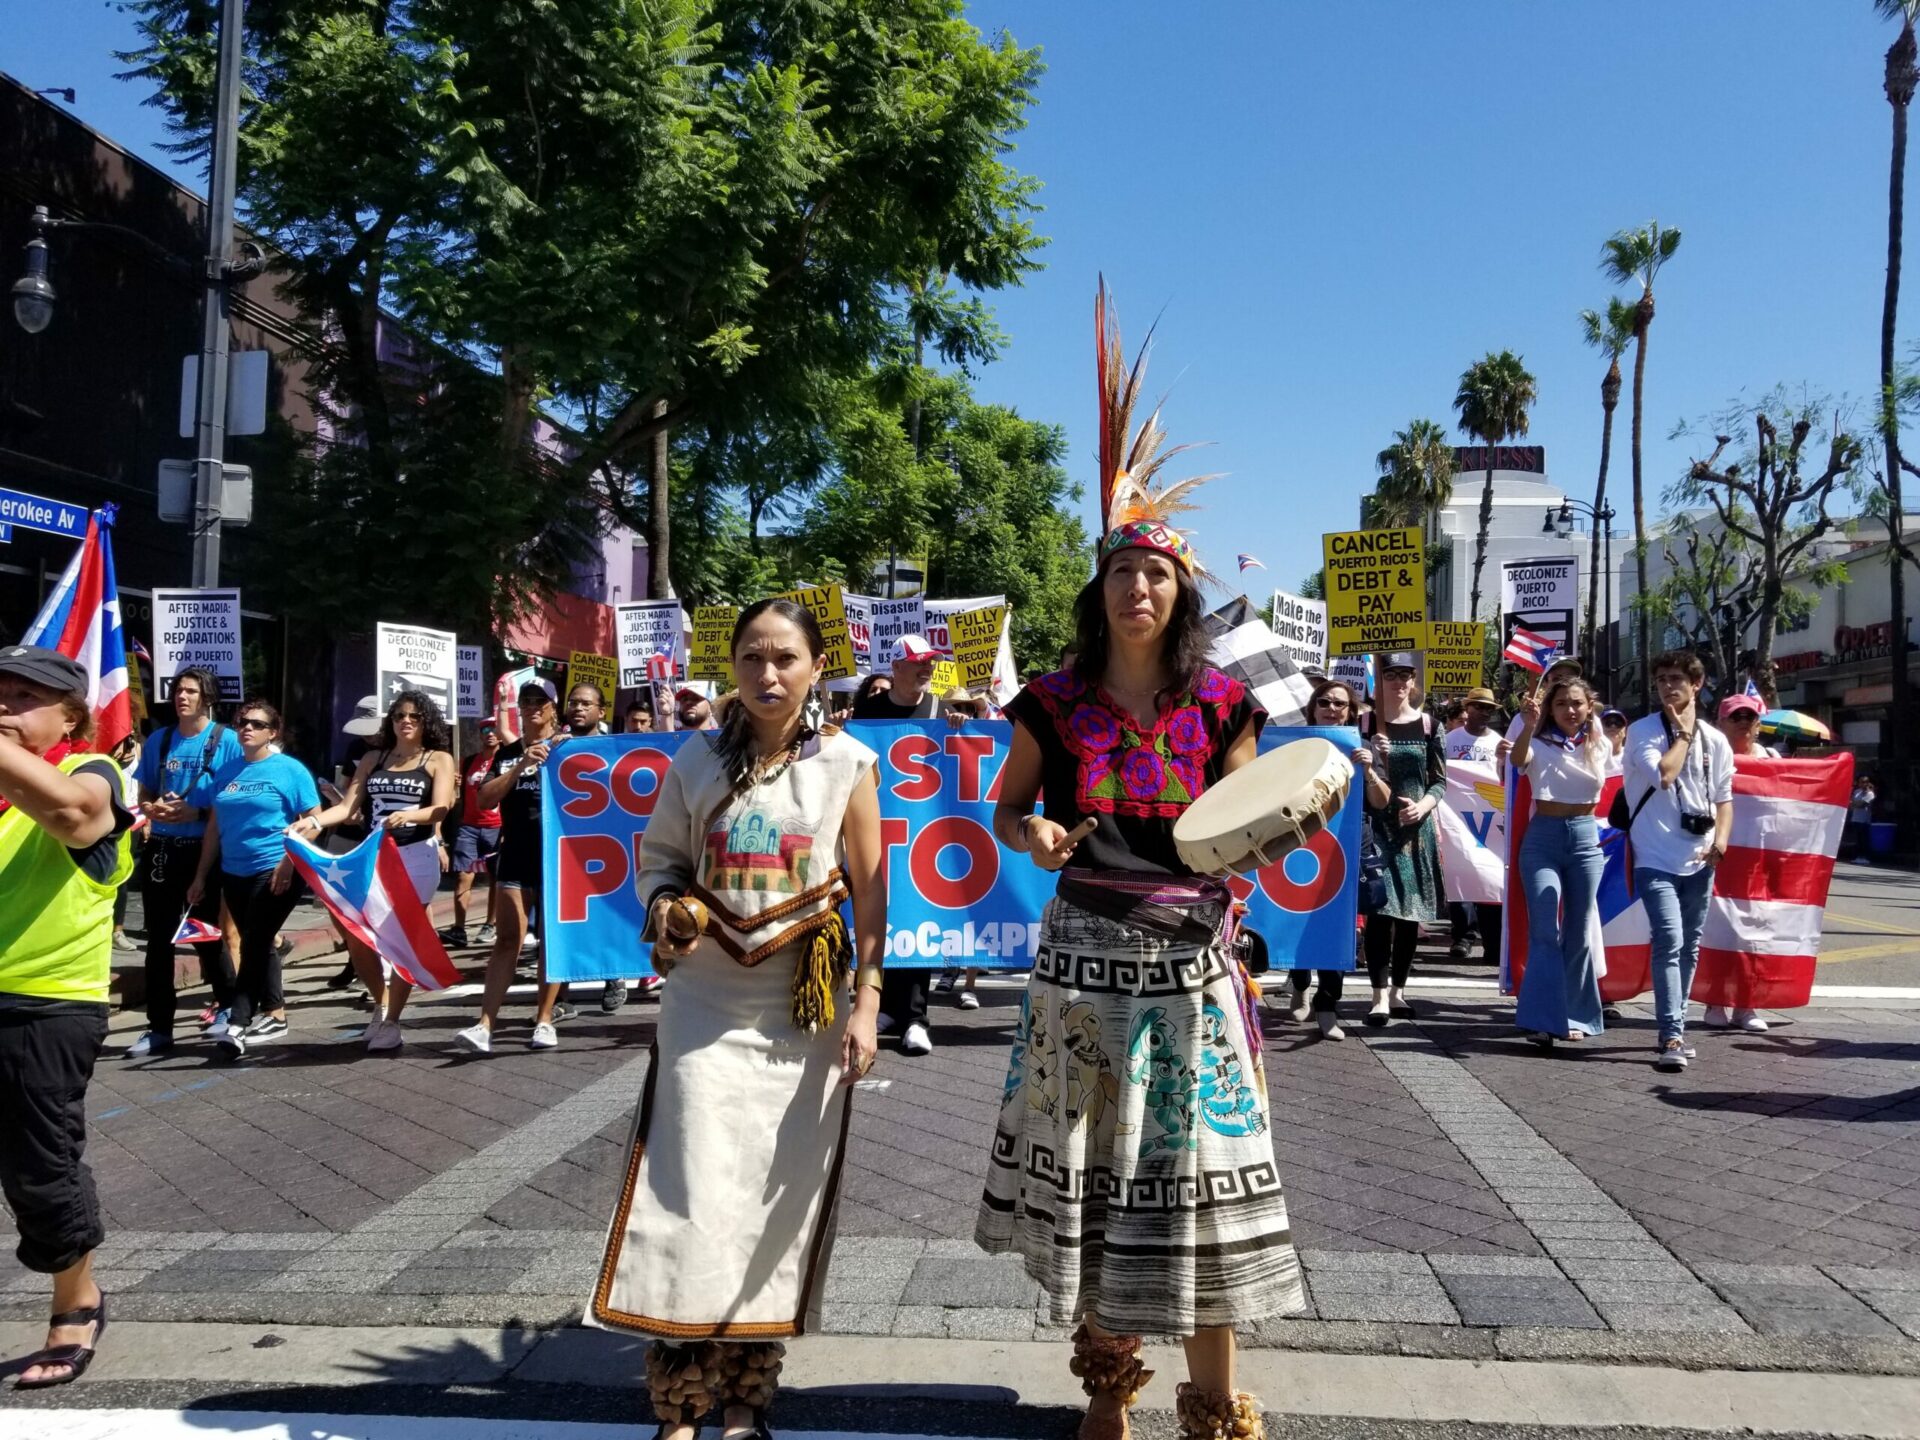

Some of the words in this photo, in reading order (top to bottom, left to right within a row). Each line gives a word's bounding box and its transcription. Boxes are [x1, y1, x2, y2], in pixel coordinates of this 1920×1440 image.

[0, 499, 53, 525] erokee
[57, 508, 76, 530] Av
[1332, 532, 1415, 554] CANCEL
[1329, 556, 1377, 570] PUERTO
[1380, 553, 1420, 566] RICO'S
[1337, 570, 1391, 591] DEBT
[1397, 569, 1413, 587] &
[1508, 567, 1568, 581] DECOLONIZE
[1516, 581, 1556, 595] PUERTO
[786, 587, 832, 607] ULLY
[1358, 593, 1395, 613] PAY
[1522, 596, 1549, 608] RICO!
[168, 603, 199, 614] AFTER
[202, 603, 231, 613] MARIA:
[697, 608, 735, 620] CANCEL
[871, 601, 919, 616] Disaster
[1275, 594, 1304, 621] Make
[1305, 609, 1322, 625] the
[625, 612, 646, 621] AFTER
[648, 610, 673, 619] MARIA:
[955, 609, 998, 629] FULLY
[1331, 611, 1422, 628] REPARATIONS
[174, 616, 217, 628] JUSTICE
[219, 616, 228, 628] &
[629, 621, 661, 632] JUSTICE
[663, 620, 670, 630] &
[695, 621, 717, 629] PUERTO
[819, 618, 845, 630] ICO'S
[873, 621, 902, 637] Puerto
[903, 620, 921, 634] Rico
[962, 624, 995, 638] FUND
[1274, 614, 1304, 642] Banks
[1306, 625, 1325, 647] Pay
[1361, 626, 1398, 640] NOW!
[1434, 624, 1479, 636] FULLY
[164, 632, 236, 644] REPARATIONS
[697, 630, 722, 642] DEBT
[723, 631, 731, 641] &
[1438, 637, 1472, 646] FUND
[388, 634, 447, 651] DECOLONIZE
[954, 638, 982, 650] PUERTO
[983, 635, 1000, 644] RICO
[1345, 641, 1412, 652] ANSWER-LA.ORG
[168, 651, 191, 661] FOR
[195, 651, 233, 661] PUERTO
[399, 648, 437, 662] PUERTO
[627, 648, 643, 656] FOR
[704, 645, 721, 655] PAY
[957, 648, 998, 664] RECOVE
[405, 660, 432, 672] RICO!
[574, 654, 615, 670] CANCEL
[937, 662, 955, 674] LLY
[1427, 660, 1480, 669] RECOVERY
[459, 668, 479, 681] Rico
[571, 663, 596, 674] PUERTO
[574, 673, 600, 685] DEBT
[602, 680, 610, 688] &
[932, 673, 950, 682] UND
[1434, 672, 1472, 684] NOW!
[460, 684, 471, 694] by
[367, 777, 389, 785] UNA
[393, 778, 425, 788] SOLA
[367, 785, 423, 795] ESTRELLA
[1461, 811, 1496, 848] V
